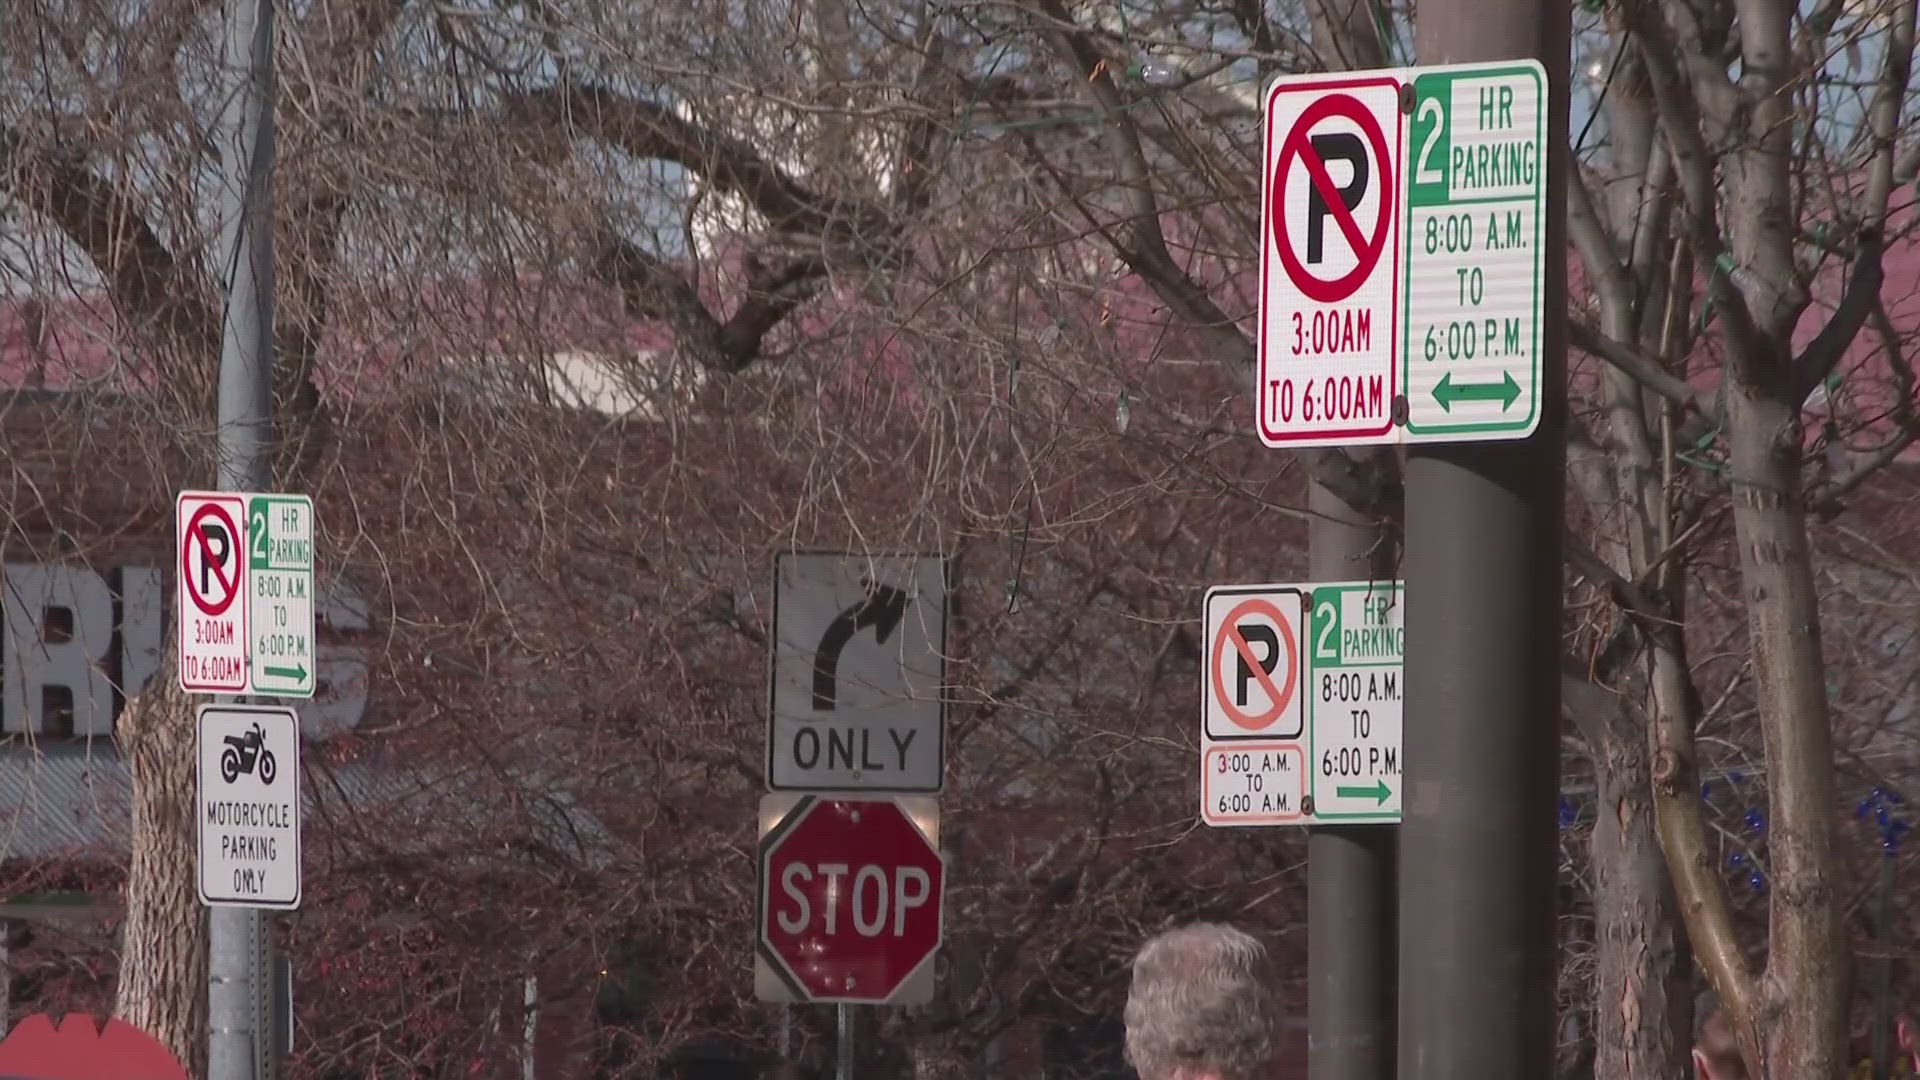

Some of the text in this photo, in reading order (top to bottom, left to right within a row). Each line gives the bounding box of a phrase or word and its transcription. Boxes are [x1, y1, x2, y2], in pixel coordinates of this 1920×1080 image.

[1478, 85, 1513, 131] HR
[1415, 96, 1444, 185] 2
[1452, 141, 1534, 190] PARKING
[1425, 210, 1527, 254] 8:00 A.M.
[1456, 267, 1483, 306] TO
[1292, 308, 1371, 356] 3:00AM
[1424, 317, 1525, 361] 6:00 P.M.
[1270, 374, 1383, 423] TO 6:00AM
[282, 507, 298, 532] HR
[252, 512, 266, 558] 2
[270, 538, 309, 563] PARKING
[258, 576, 307, 599] 8:00 A.M.
[274, 605, 286, 626] TO
[1364, 597, 1387, 625] HR
[195, 619, 233, 644] 3:00AM
[1316, 602, 1336, 658] 2
[259, 635, 307, 657] 6:00 P.M.
[186, 656, 240, 681] TO 6:00AM
[1322, 672, 1400, 702] 8:00 A.M.
[1351, 710, 1370, 738] TO
[793, 727, 917, 771] ONLY
[1322, 748, 1401, 775] 6:00 P.M.
[1218, 753, 1290, 774] 3:00 A.M.
[1246, 774, 1262, 792] TO
[207, 801, 289, 828] MOTORCYCLE
[1219, 794, 1290, 812] 6:00 A.M.
[222, 835, 276, 861] PARKING
[234, 868, 265, 893] ONLY
[777, 862, 930, 937] STOP
